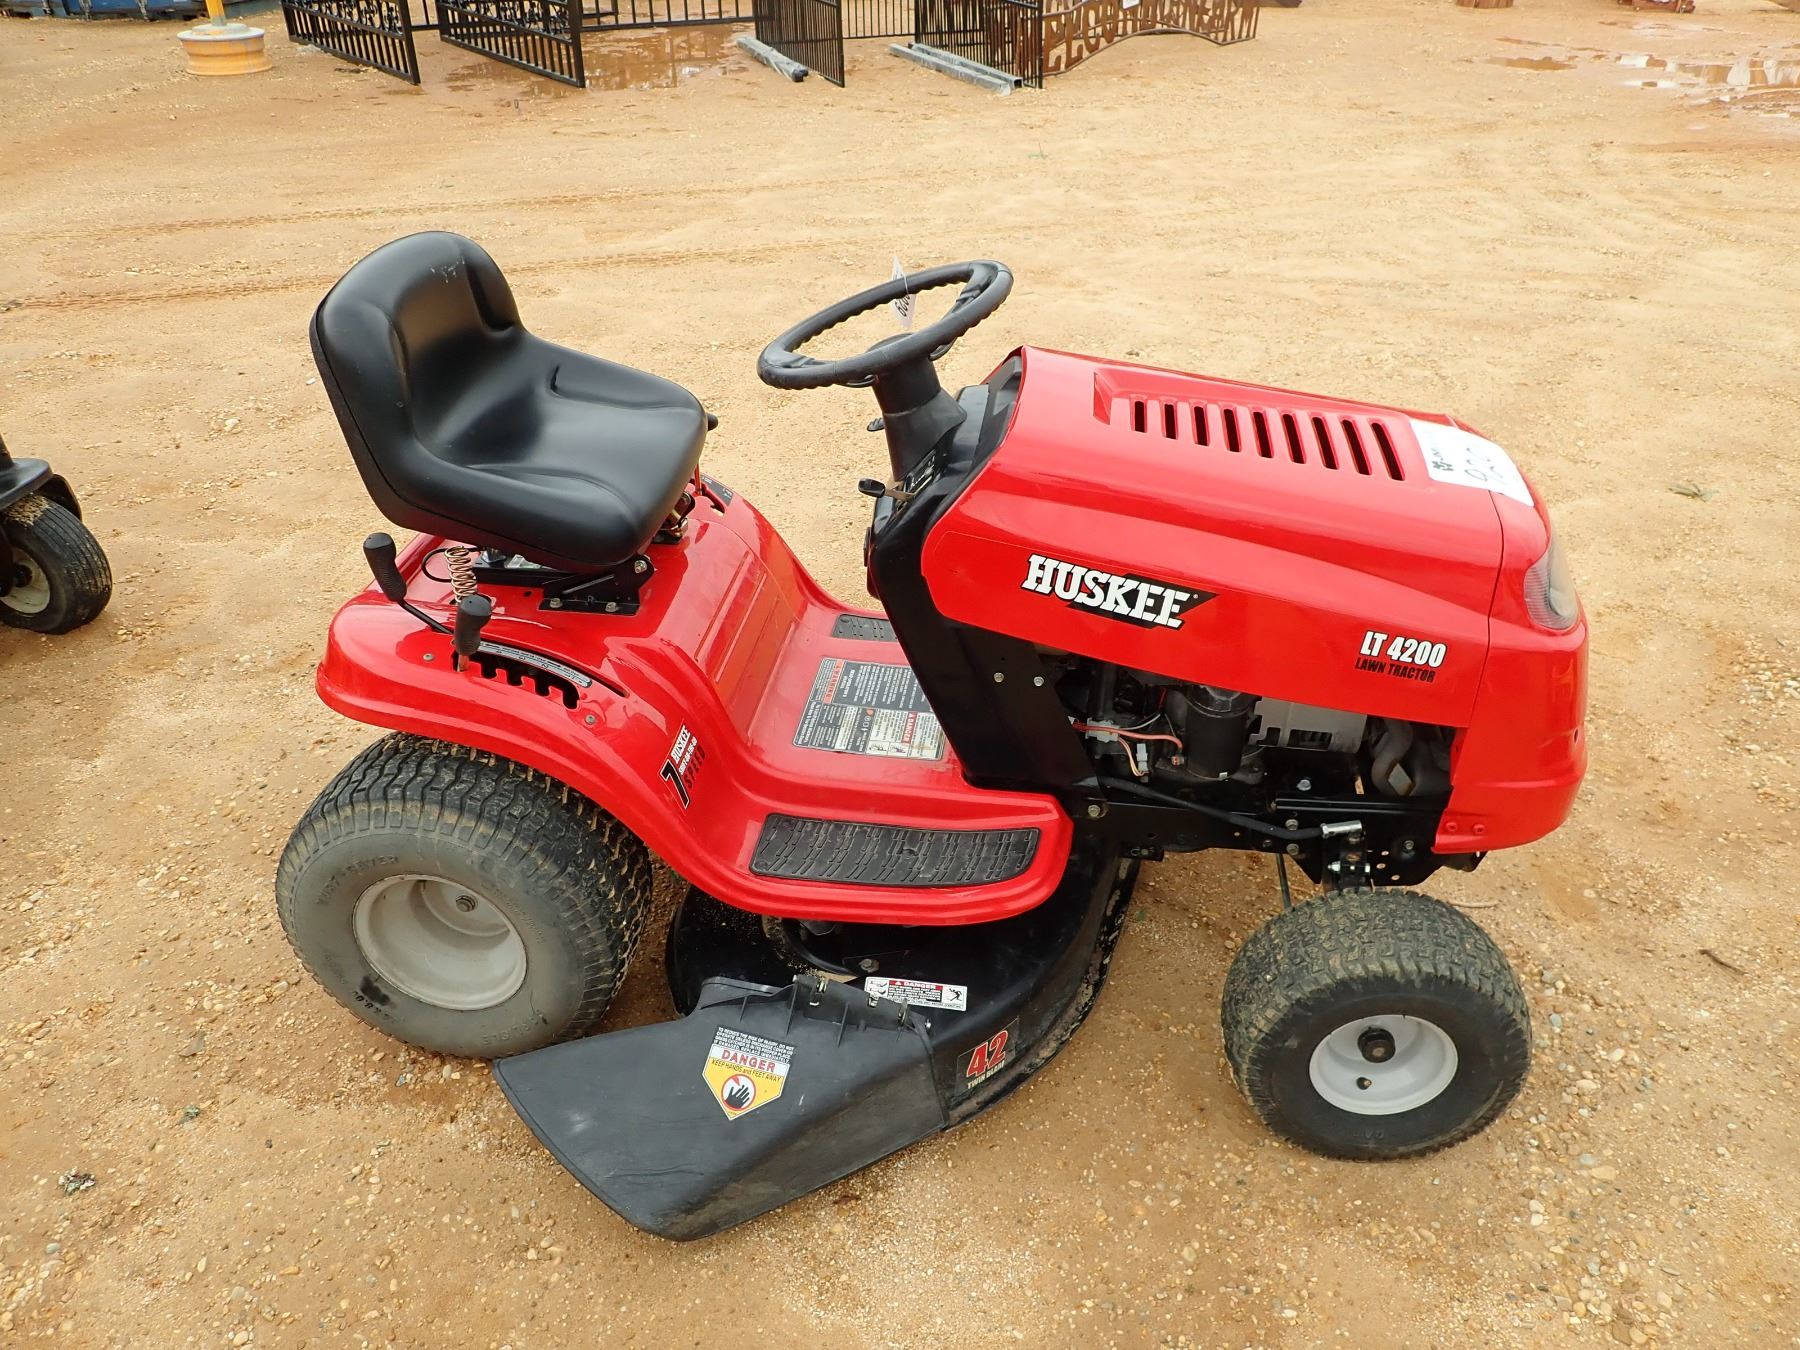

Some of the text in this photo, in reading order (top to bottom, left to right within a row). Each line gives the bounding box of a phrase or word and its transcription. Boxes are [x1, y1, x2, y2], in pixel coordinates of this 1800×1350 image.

[1021, 554, 1190, 629] HUSKEE
[1360, 630, 1447, 668] LT 4200
[1355, 657, 1436, 683] LAWN TRACTOR
[660, 758, 690, 809] 7
[683, 744, 706, 789] SPEED
[903, 981, 937, 990] DANGER
[721, 1049, 776, 1072] DANGER
[966, 1030, 1009, 1077] 42
[712, 1060, 726, 1068] KEEP
[726, 1064, 742, 1072] HANDS
[752, 1070, 765, 1078] FEET
[765, 1074, 781, 1083] AWAY
[967, 1059, 1006, 1090] TWIN BLADE
